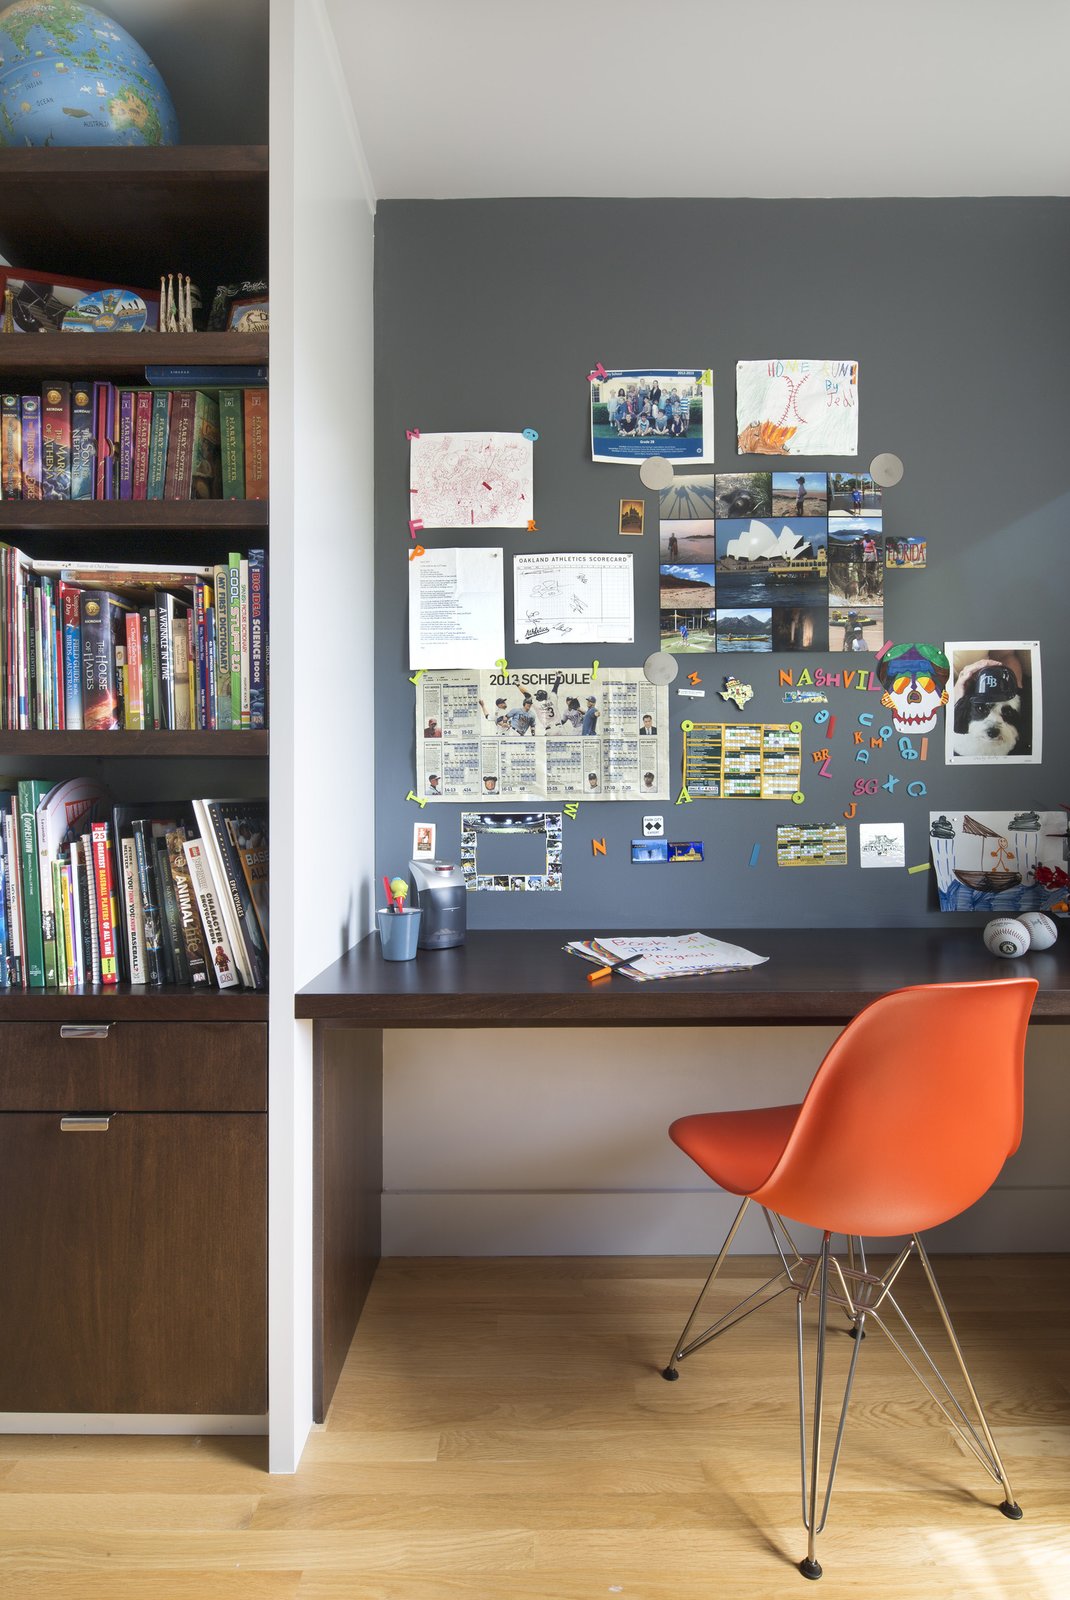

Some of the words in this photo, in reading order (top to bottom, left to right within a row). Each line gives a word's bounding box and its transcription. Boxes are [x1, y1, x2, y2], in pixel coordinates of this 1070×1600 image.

[37, 98, 54, 106] OCEAN
[695, 368, 713, 387] A
[767, 361, 810, 377] HOME
[825, 380, 839, 393] By
[46, 423, 52, 434] OF
[43, 435, 54, 479] ATHENA
[56, 443, 67, 476] MARK
[72, 428, 80, 478] NEPTUNE
[81, 442, 94, 467] SON
[527, 520, 539, 532] R
[409, 544, 426, 560] P
[886, 543, 925, 562] FLORIDA
[219, 577, 226, 590] MY
[230, 569, 239, 603] COOL
[252, 573, 260, 591] BIG
[219, 592, 227, 615] FIRST
[252, 593, 260, 618] IDEA
[160, 614, 168, 648] WRINKLE
[231, 606, 240, 651] STUFF
[85, 641, 91, 652] OF
[96, 640, 105, 654] THE
[220, 617, 228, 670] DICTIONARY
[252, 619, 260, 660] SCIENCE
[161, 651, 168, 660] IN
[84, 653, 94, 690] HADES
[96, 654, 108, 690] HOUSE
[489, 674, 520, 686] 2013
[522, 673, 590, 686] SCHEDULE
[548, 707, 555, 718] 3
[854, 731, 865, 745] K
[870, 737, 883, 749] M
[676, 787, 693, 804] A
[843, 803, 857, 819] J
[21, 813, 34, 853] COOPERSTOWN
[97, 842, 105, 868] GREATEST
[592, 838, 607, 857] N
[99, 870, 108, 896] BASEBALL
[230, 880, 238, 892] EPIC
[166, 886, 174, 922] NAVIGATING
[170, 924, 178, 942] EARLY
[175, 876, 193, 927] ANIMAL
[185, 927, 200, 952] life
[233, 893, 244, 917] VOYAGES
[200, 894, 216, 944] ENCYCLOPEDIA
[206, 893, 223, 943] CHARACTER
[104, 941, 112, 954] TIME
[678, 936, 699, 944] of
